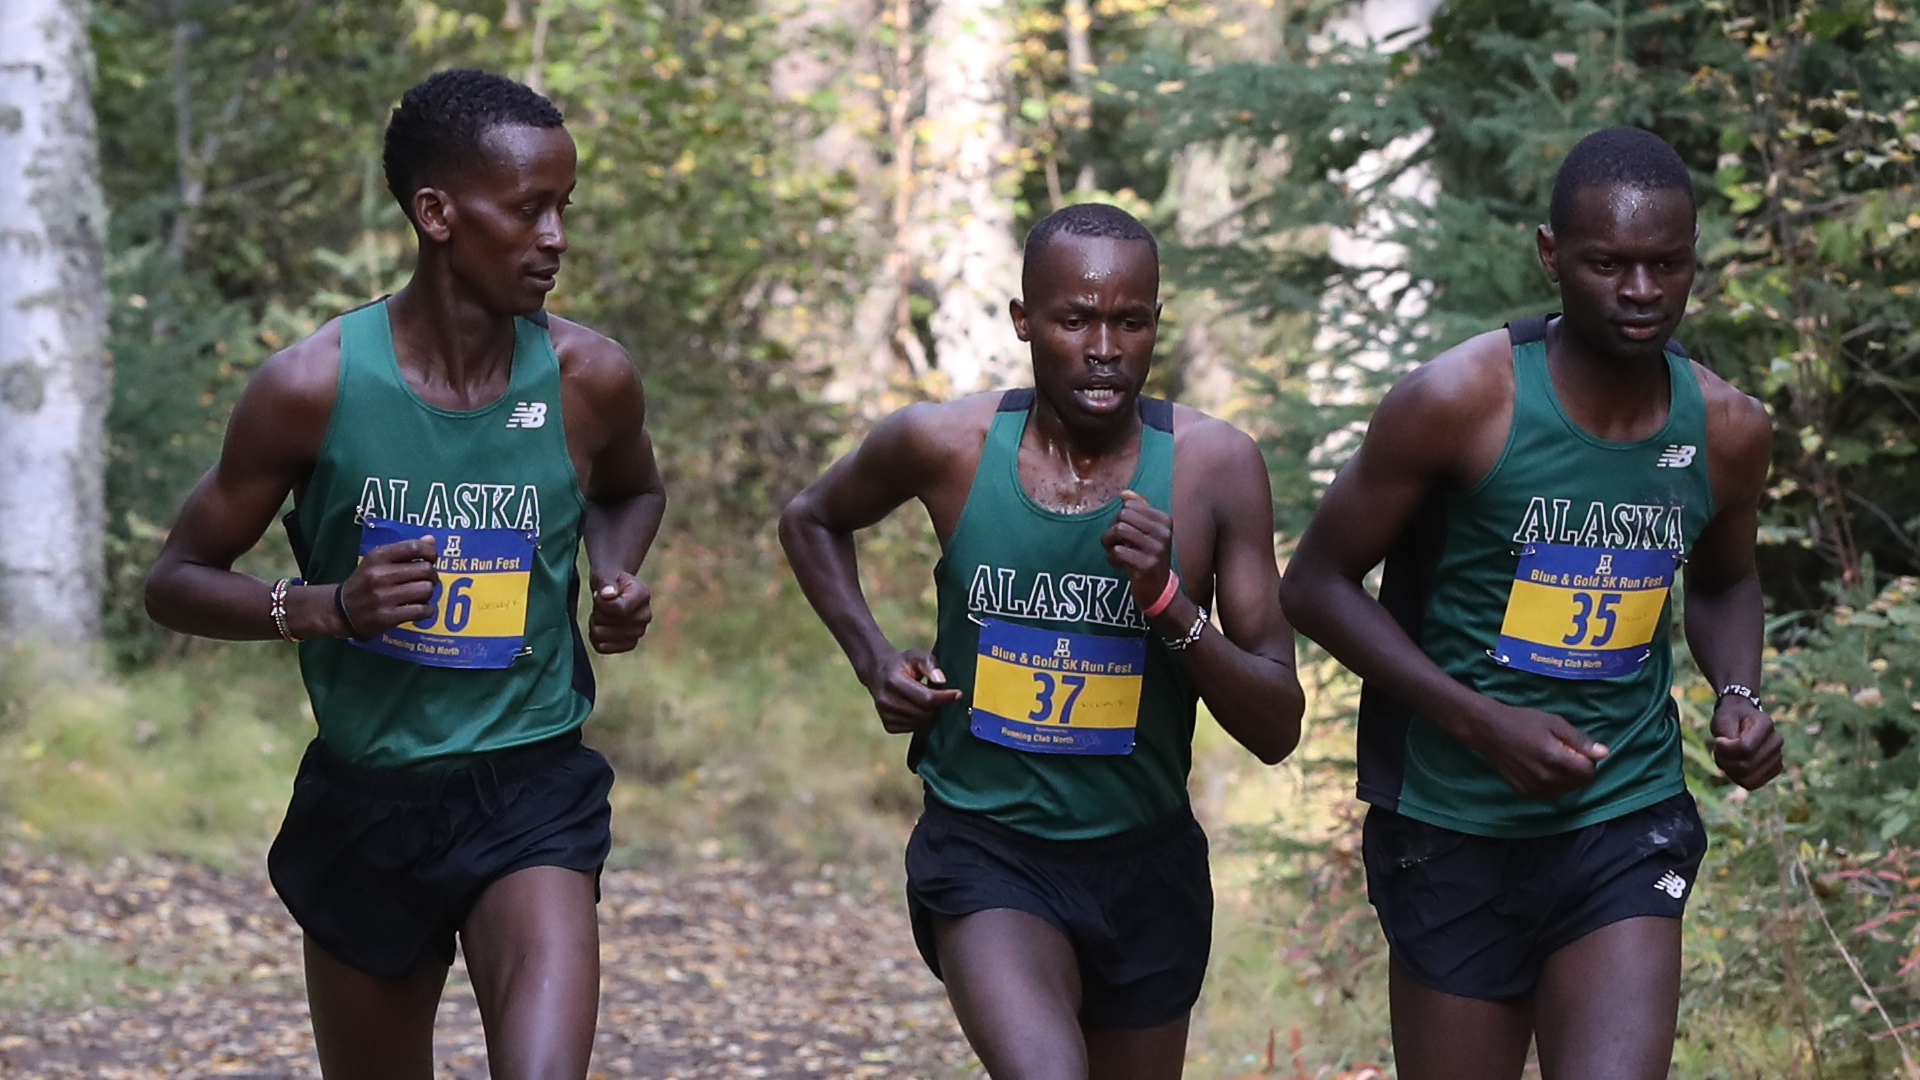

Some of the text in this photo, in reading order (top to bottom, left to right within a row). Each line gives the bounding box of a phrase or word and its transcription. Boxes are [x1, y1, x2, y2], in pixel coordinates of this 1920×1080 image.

[354, 477, 541, 536] ALASKA
[1513, 496, 1685, 554] ALASKA
[451, 558, 468, 571] 5K
[470, 557, 493, 571] Run
[495, 556, 520, 570] Fest
[1530, 568, 1664, 589] Blue & Gold 5K Run Fest
[967, 564, 1147, 630] ALASKA
[1562, 592, 1622, 648] 35
[416, 643, 436, 654] Club
[437, 646, 460, 656] North
[991, 645, 1132, 674] Blue & Gold 5K Run Fest
[1530, 652, 1563, 668] Running
[1028, 671, 1086, 724] 37
[1001, 726, 1032, 743] Running
[1033, 732, 1051, 743] Club
